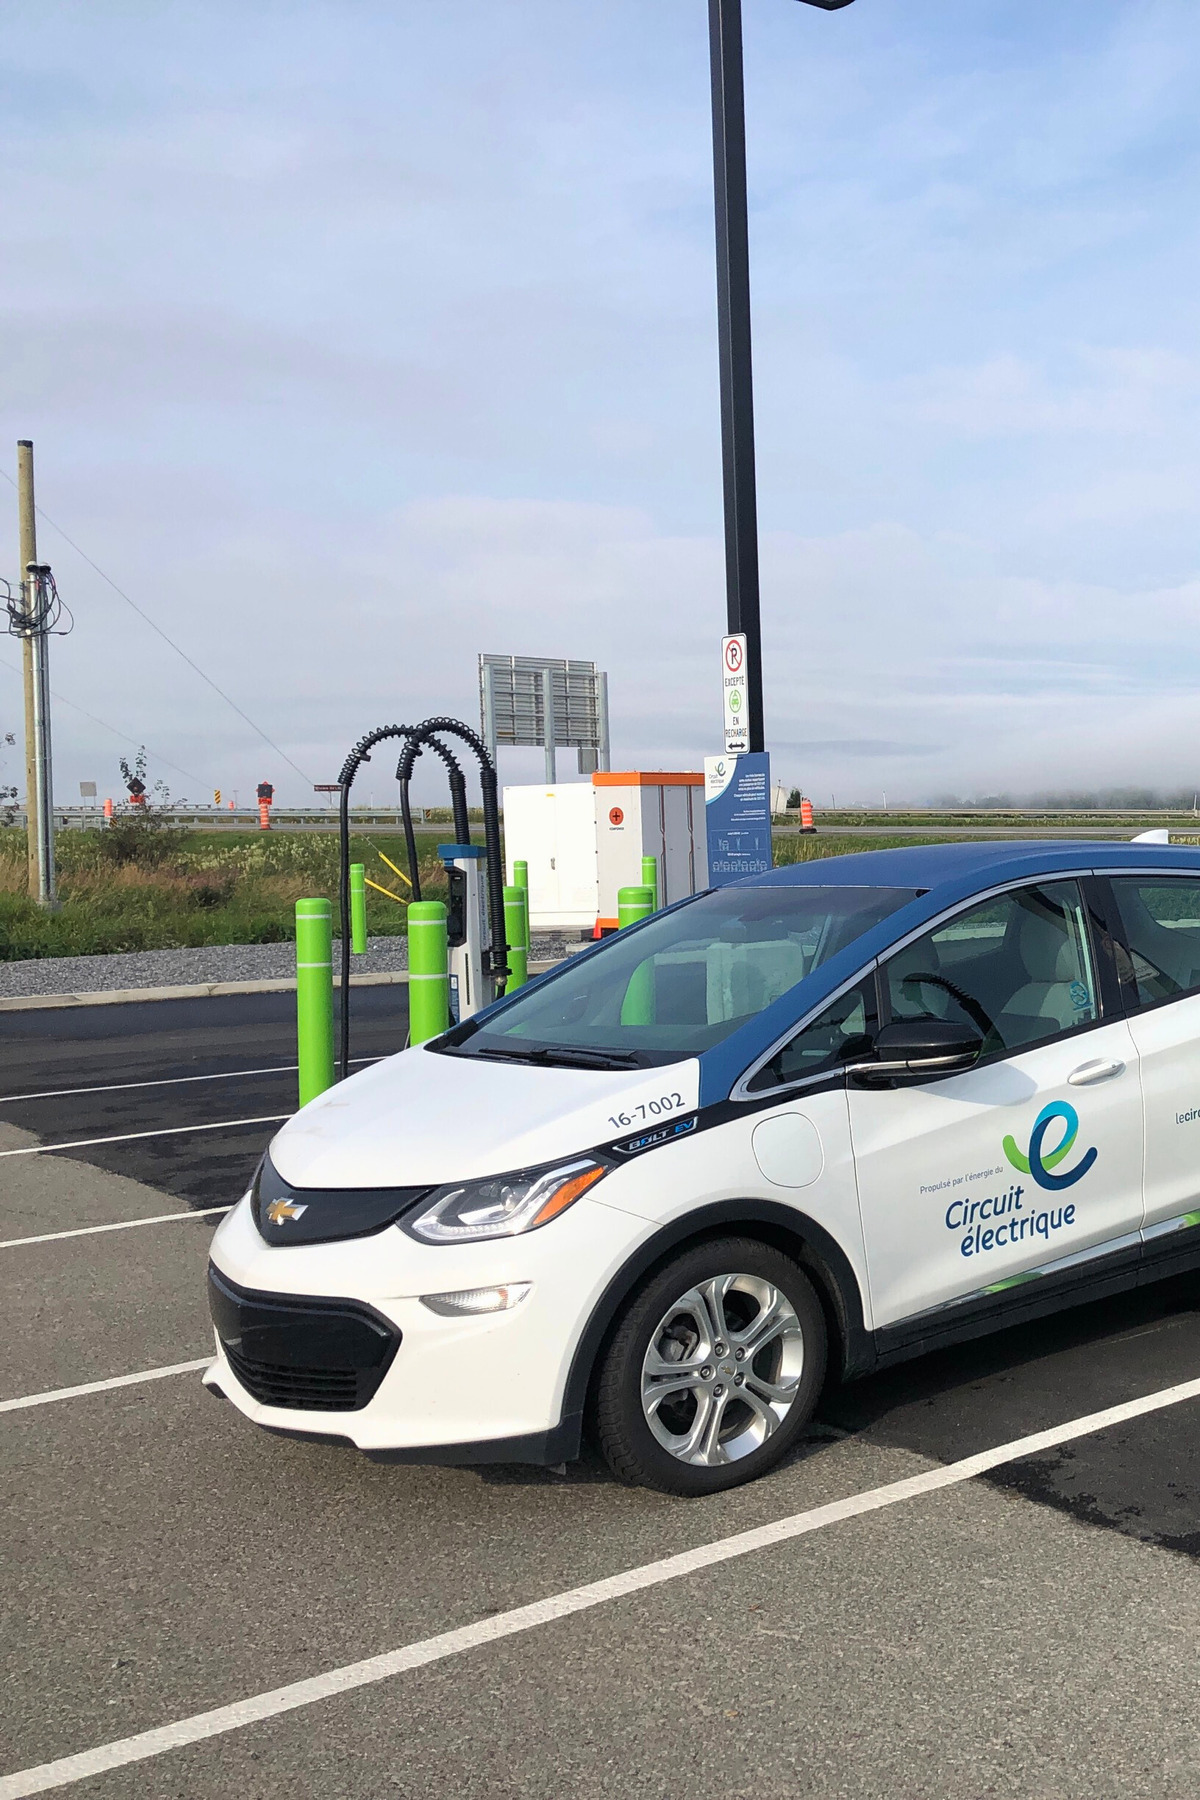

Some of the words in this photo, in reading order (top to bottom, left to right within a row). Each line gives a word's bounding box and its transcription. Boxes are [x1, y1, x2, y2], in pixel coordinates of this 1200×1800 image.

[725, 728, 748, 738] RECHARGE
[732, 716, 739, 726] EN
[608, 1092, 686, 1129] 16-7002
[629, 1129, 669, 1150] BOLT
[675, 1120, 693, 1133] EV
[920, 1178, 951, 1194] Propulsé
[952, 1177, 964, 1187] par
[965, 1168, 994, 1182] l'énergie
[994, 1166, 1004, 1176] du
[945, 1185, 1025, 1229] Circuit
[960, 1204, 1076, 1257] électrique
